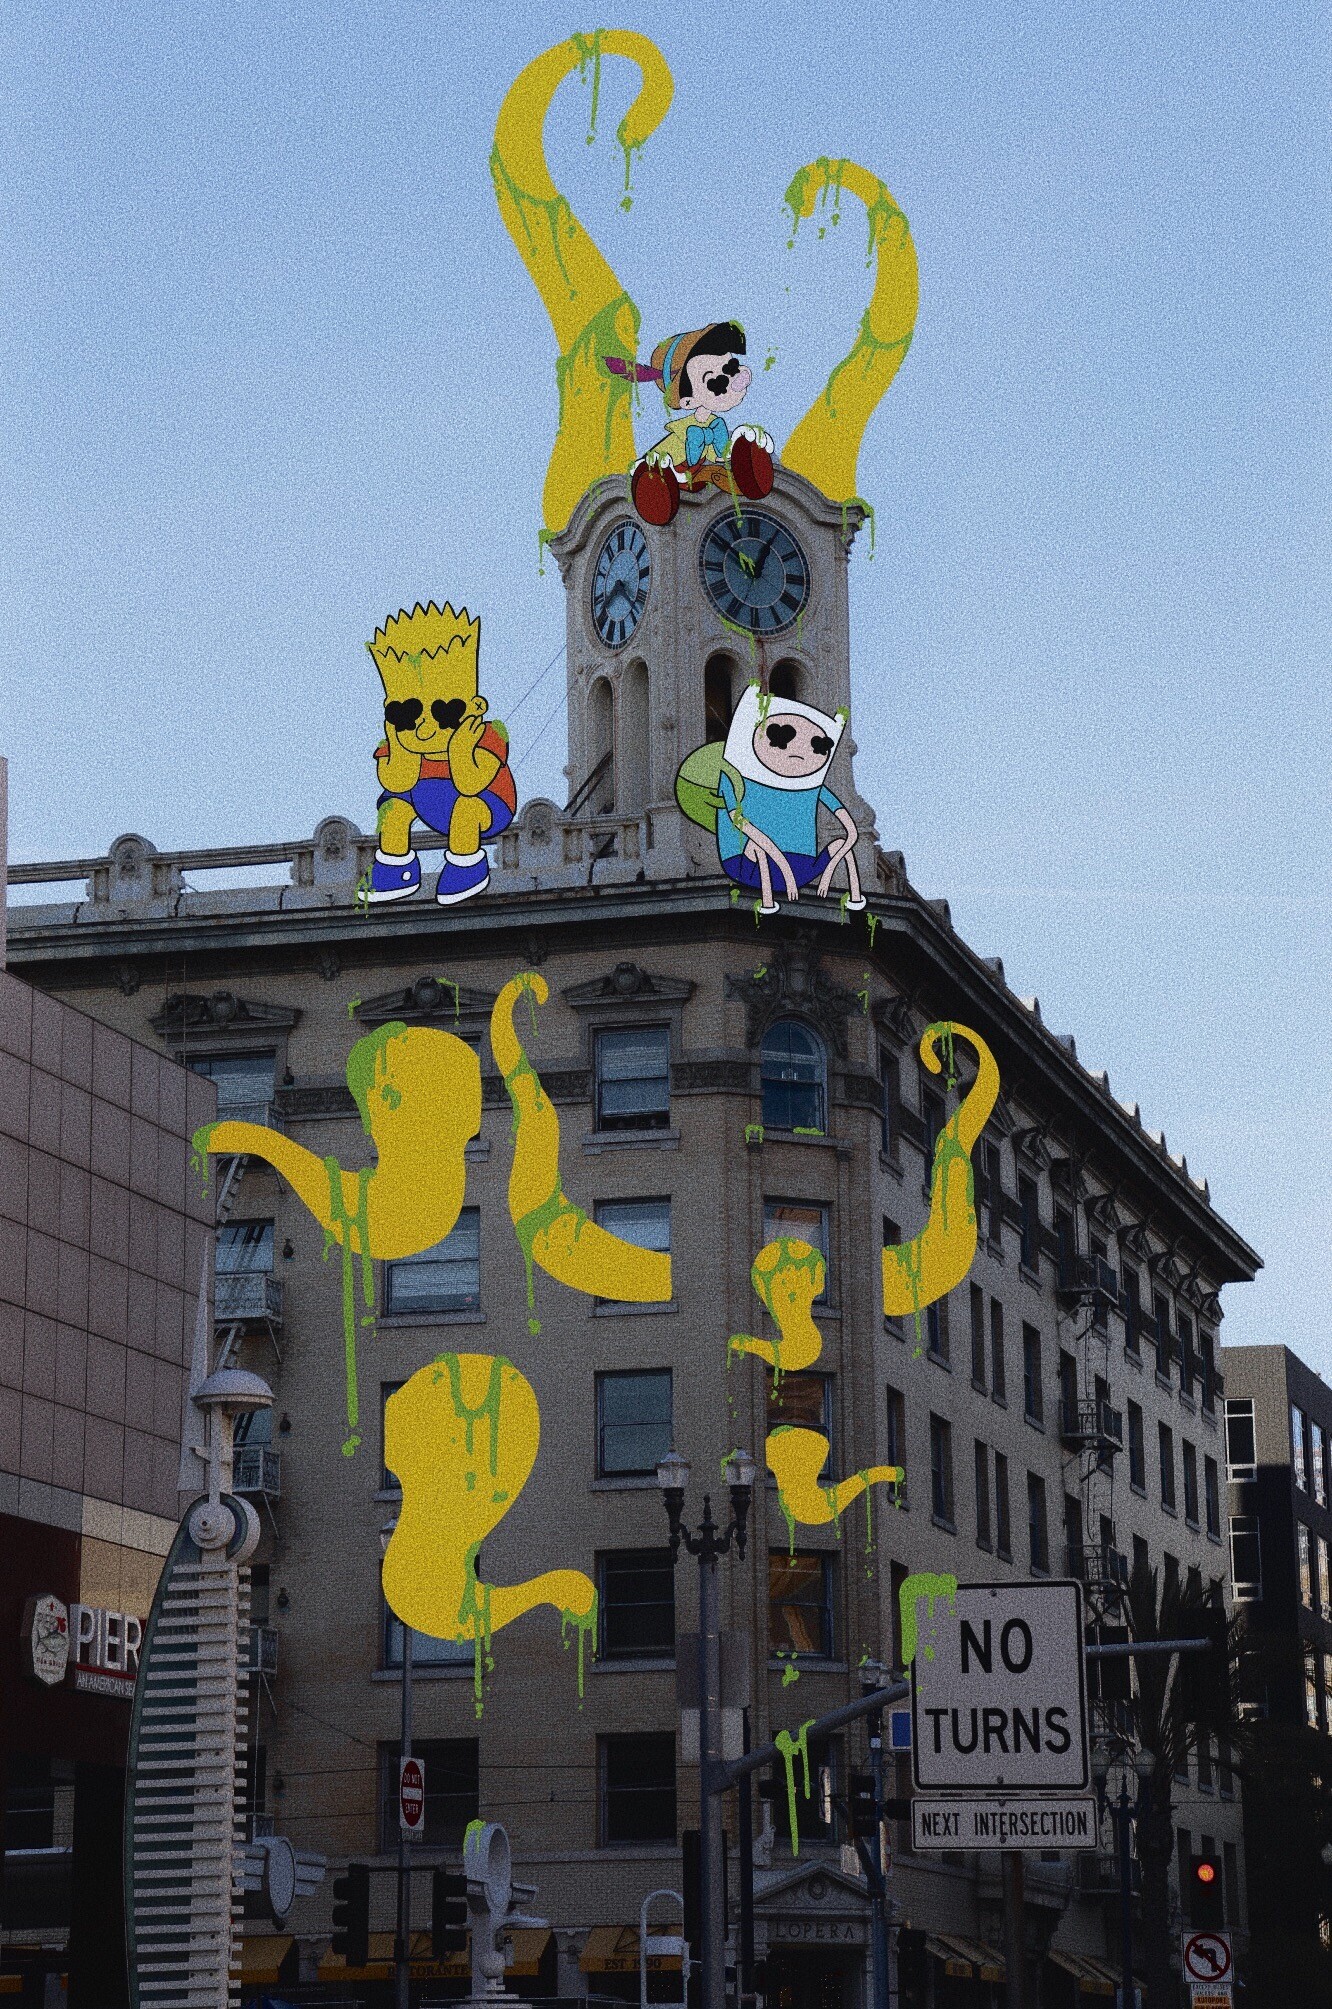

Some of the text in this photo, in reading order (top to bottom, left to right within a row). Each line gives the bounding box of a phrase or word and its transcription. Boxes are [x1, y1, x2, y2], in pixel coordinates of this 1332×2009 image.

[76, 1604, 141, 1672] PIER
[960, 1617, 1033, 1674] NO
[925, 1706, 1071, 1754] TURNS
[403, 1773, 420, 1785] DO NOT
[405, 1802, 419, 1814] ENTER
[921, 1811, 1088, 1837] NEXT INTERSECTION
[387, 1964, 468, 1977] RTORANTE
[604, 1958, 626, 1970] EST
